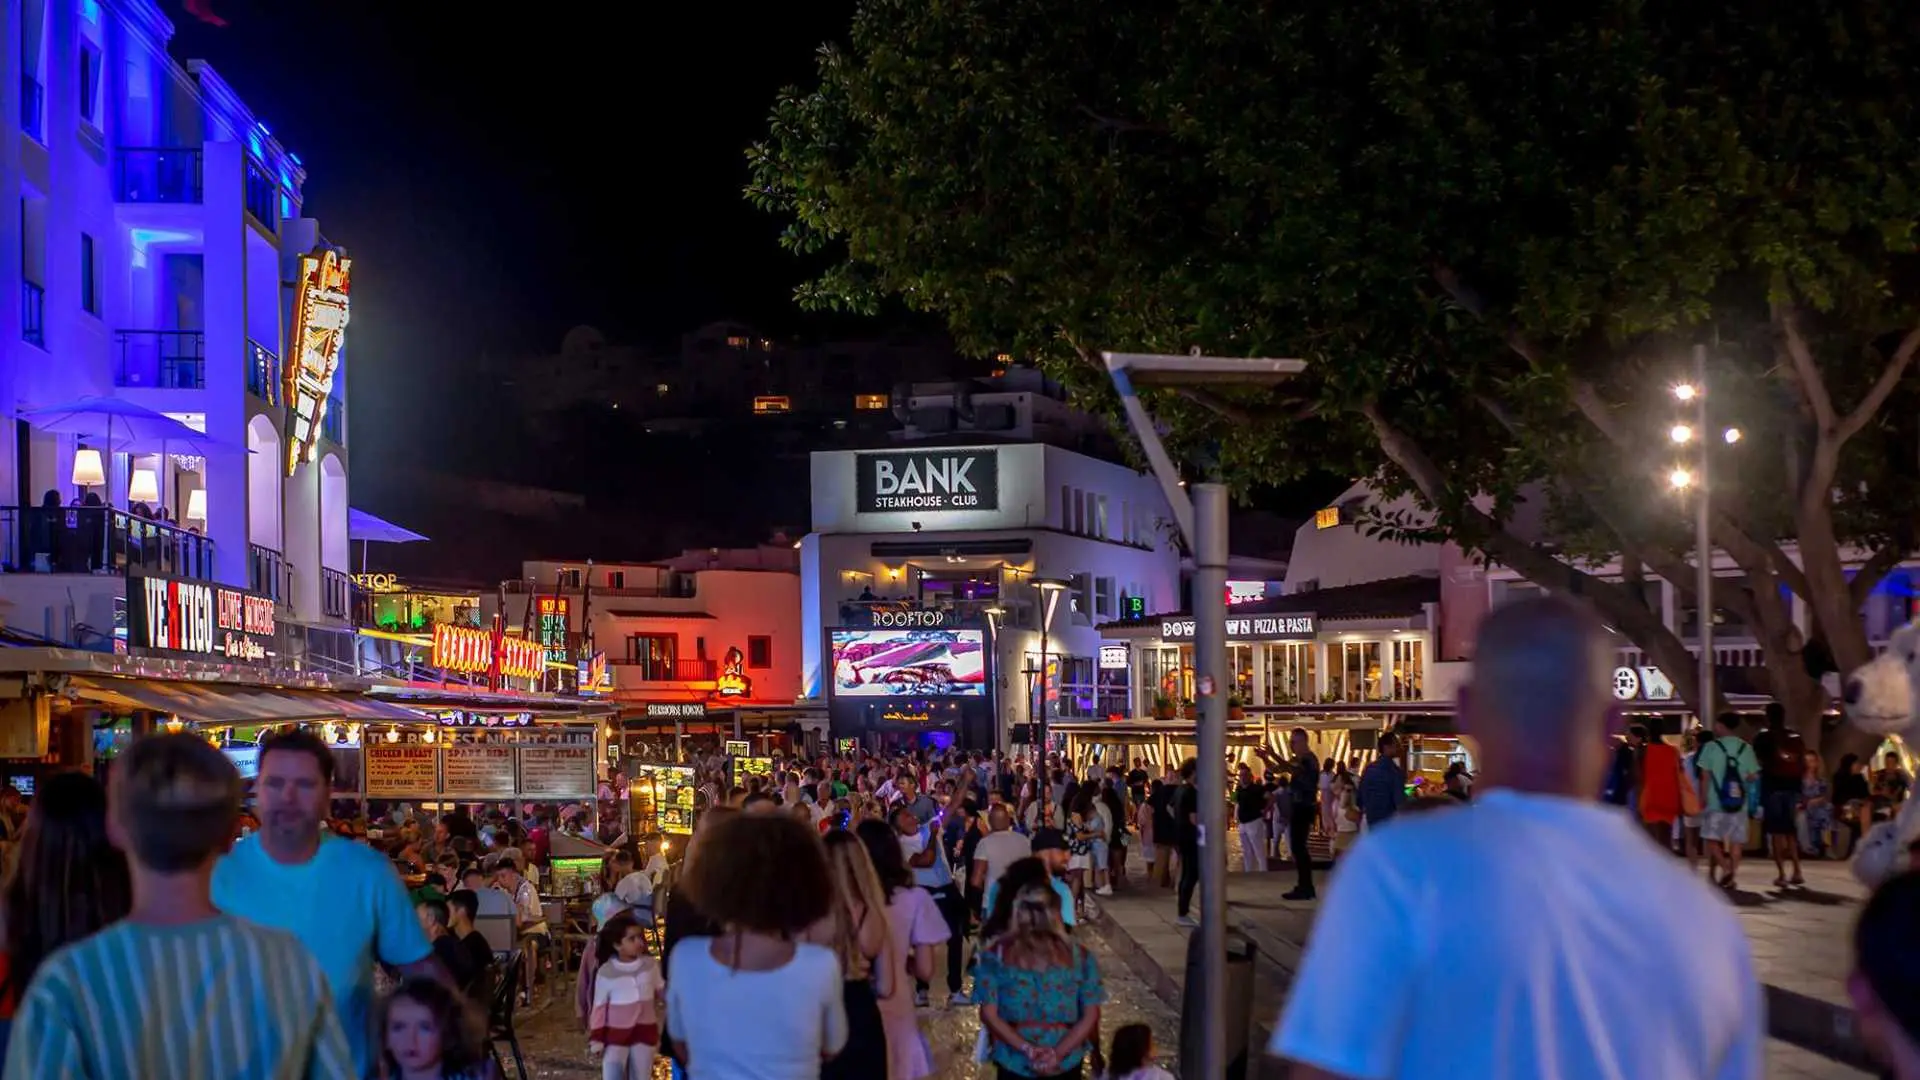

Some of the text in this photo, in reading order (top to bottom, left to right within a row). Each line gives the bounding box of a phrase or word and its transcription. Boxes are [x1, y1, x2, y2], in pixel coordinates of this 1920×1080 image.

[875, 457, 976, 495] BANK
[876, 494, 978, 508] STEAKHOUSE CLUB
[218, 589, 276, 636] LIVE MUSIC
[872, 611, 943, 627] ROOFTOP
[1162, 617, 1313, 637] DOWWN PIZZA & PASTA
